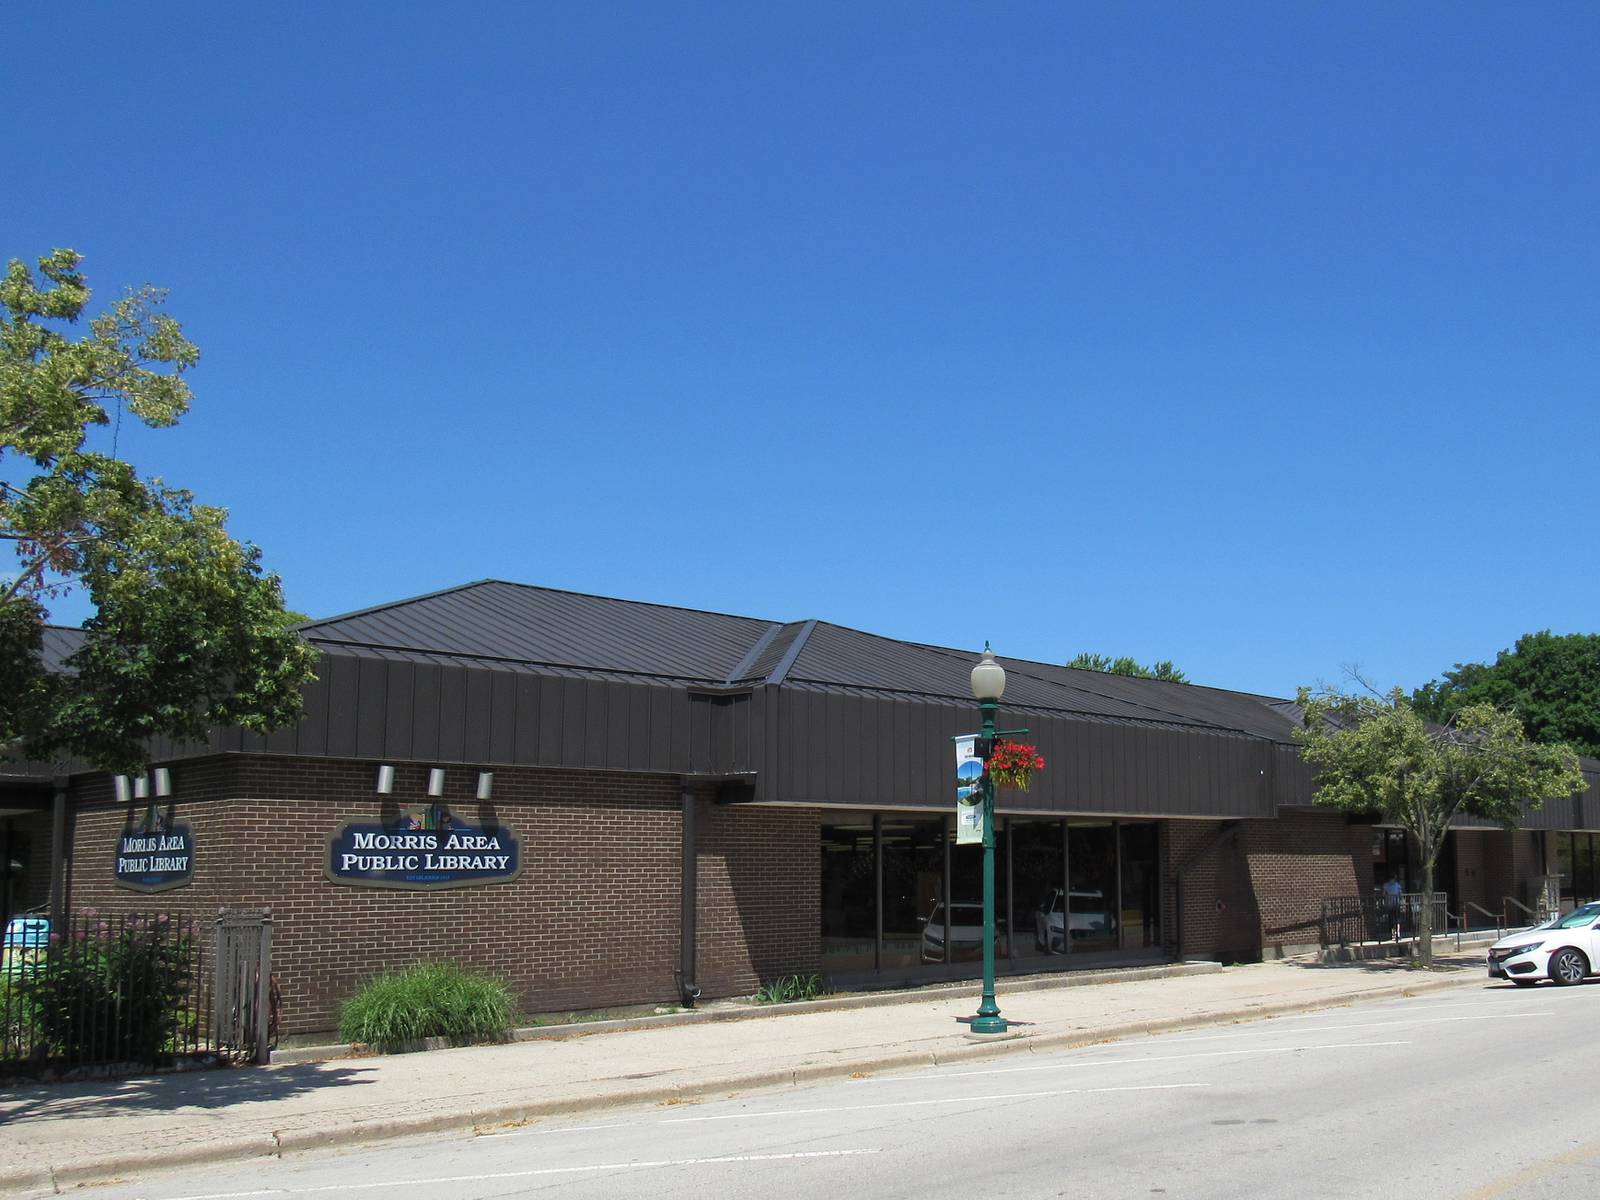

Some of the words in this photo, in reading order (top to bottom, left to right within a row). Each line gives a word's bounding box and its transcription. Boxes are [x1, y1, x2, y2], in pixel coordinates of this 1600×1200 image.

[123, 838, 157, 853] MORRIS
[158, 835, 185, 851] AREA
[353, 833, 438, 850] MORRIS
[444, 834, 501, 850] AREA
[118, 857, 148, 873] PUBLIC
[149, 856, 189, 871] LIBRARY
[341, 854, 419, 871] PUBLIC
[424, 853, 510, 870] LIBRARY
